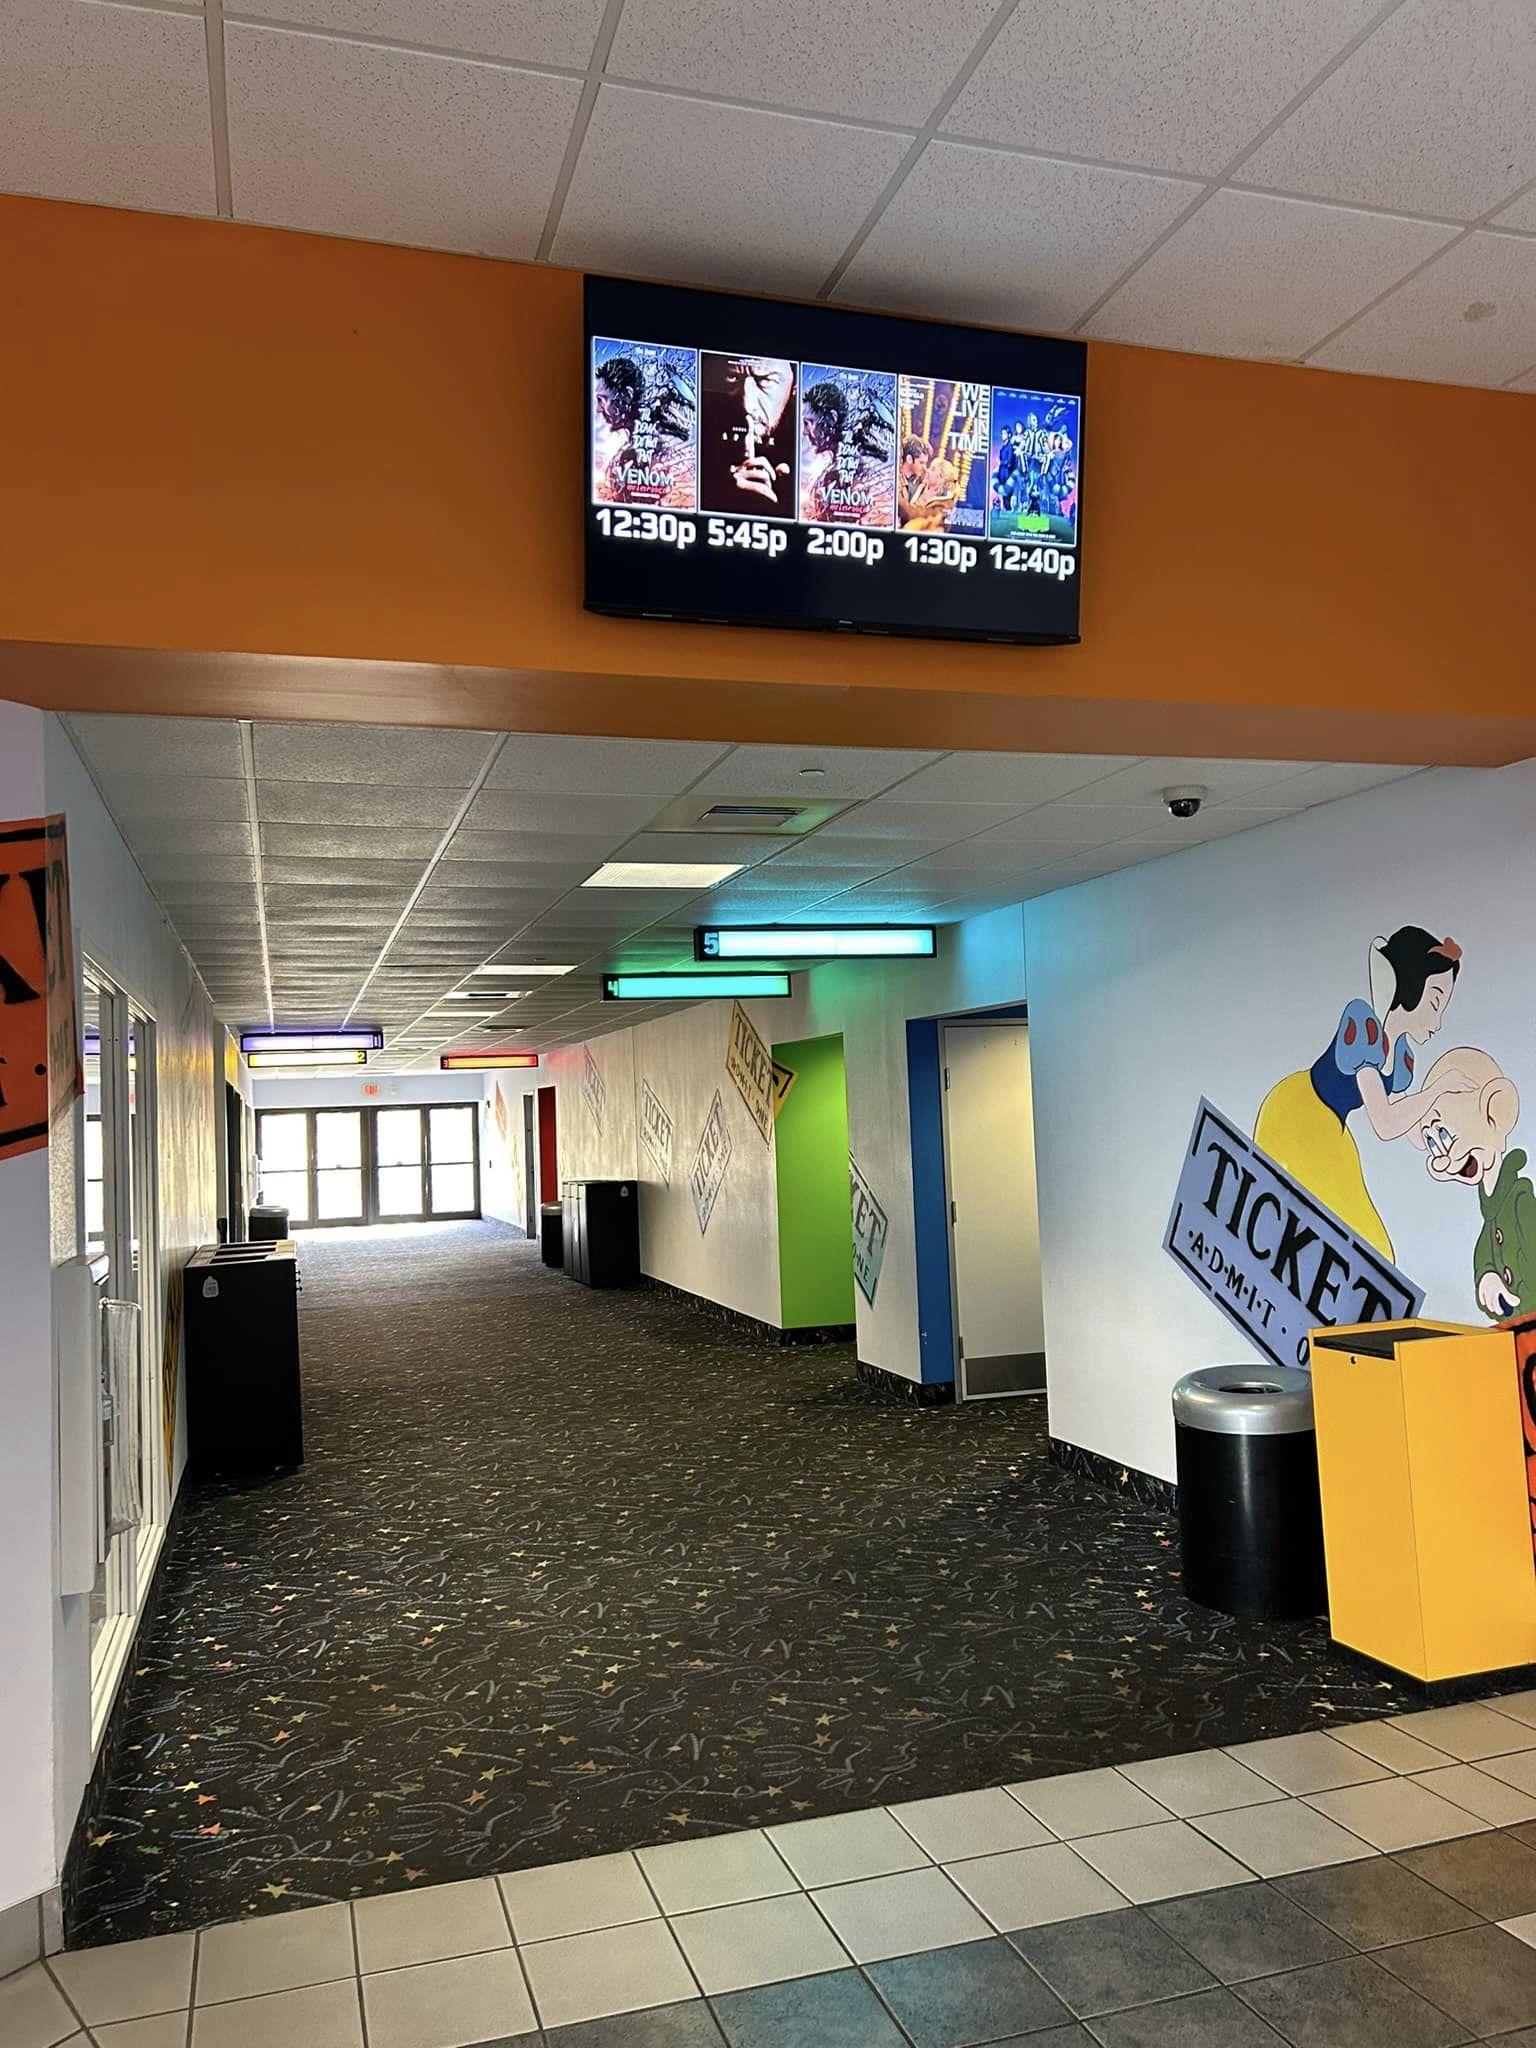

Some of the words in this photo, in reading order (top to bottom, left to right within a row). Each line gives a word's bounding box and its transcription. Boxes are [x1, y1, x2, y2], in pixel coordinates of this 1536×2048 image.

[949, 432, 989, 454] TIME
[616, 460, 673, 487] VENOM
[820, 480, 873, 506] VENOM
[596, 508, 697, 549] 12:30p
[708, 518, 787, 557] 5:45p
[807, 528, 884, 565] 2:00p
[904, 536, 977, 573] 1:30p
[990, 544, 1075, 580] 12:40p
[703, 932, 719, 955] 5
[607, 980, 619, 997] 4
[357, 1051, 366, 1063] 2
[734, 1012, 779, 1109] TICKET
[645, 1092, 671, 1153] TICKET
[694, 1101, 723, 1199] TICKET
[1204, 1142, 1392, 1327] TICKET
